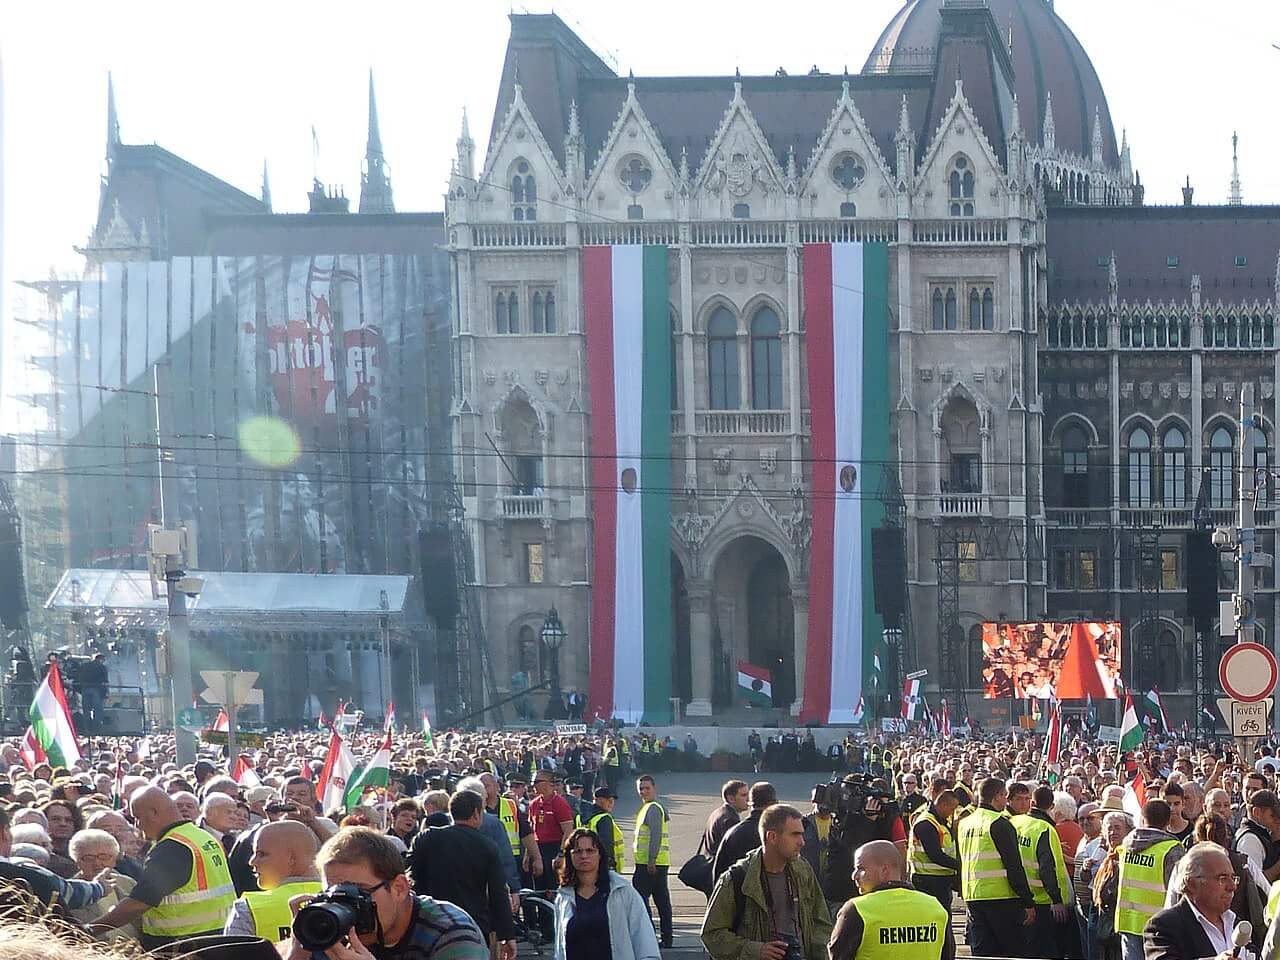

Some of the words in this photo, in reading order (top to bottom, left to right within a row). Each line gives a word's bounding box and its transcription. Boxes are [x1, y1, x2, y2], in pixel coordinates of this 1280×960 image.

[1236, 705, 1263, 715] KIVÉVE
[1123, 851, 1155, 868] ENDEZŐ
[879, 922, 937, 945] RENDEZŐ
